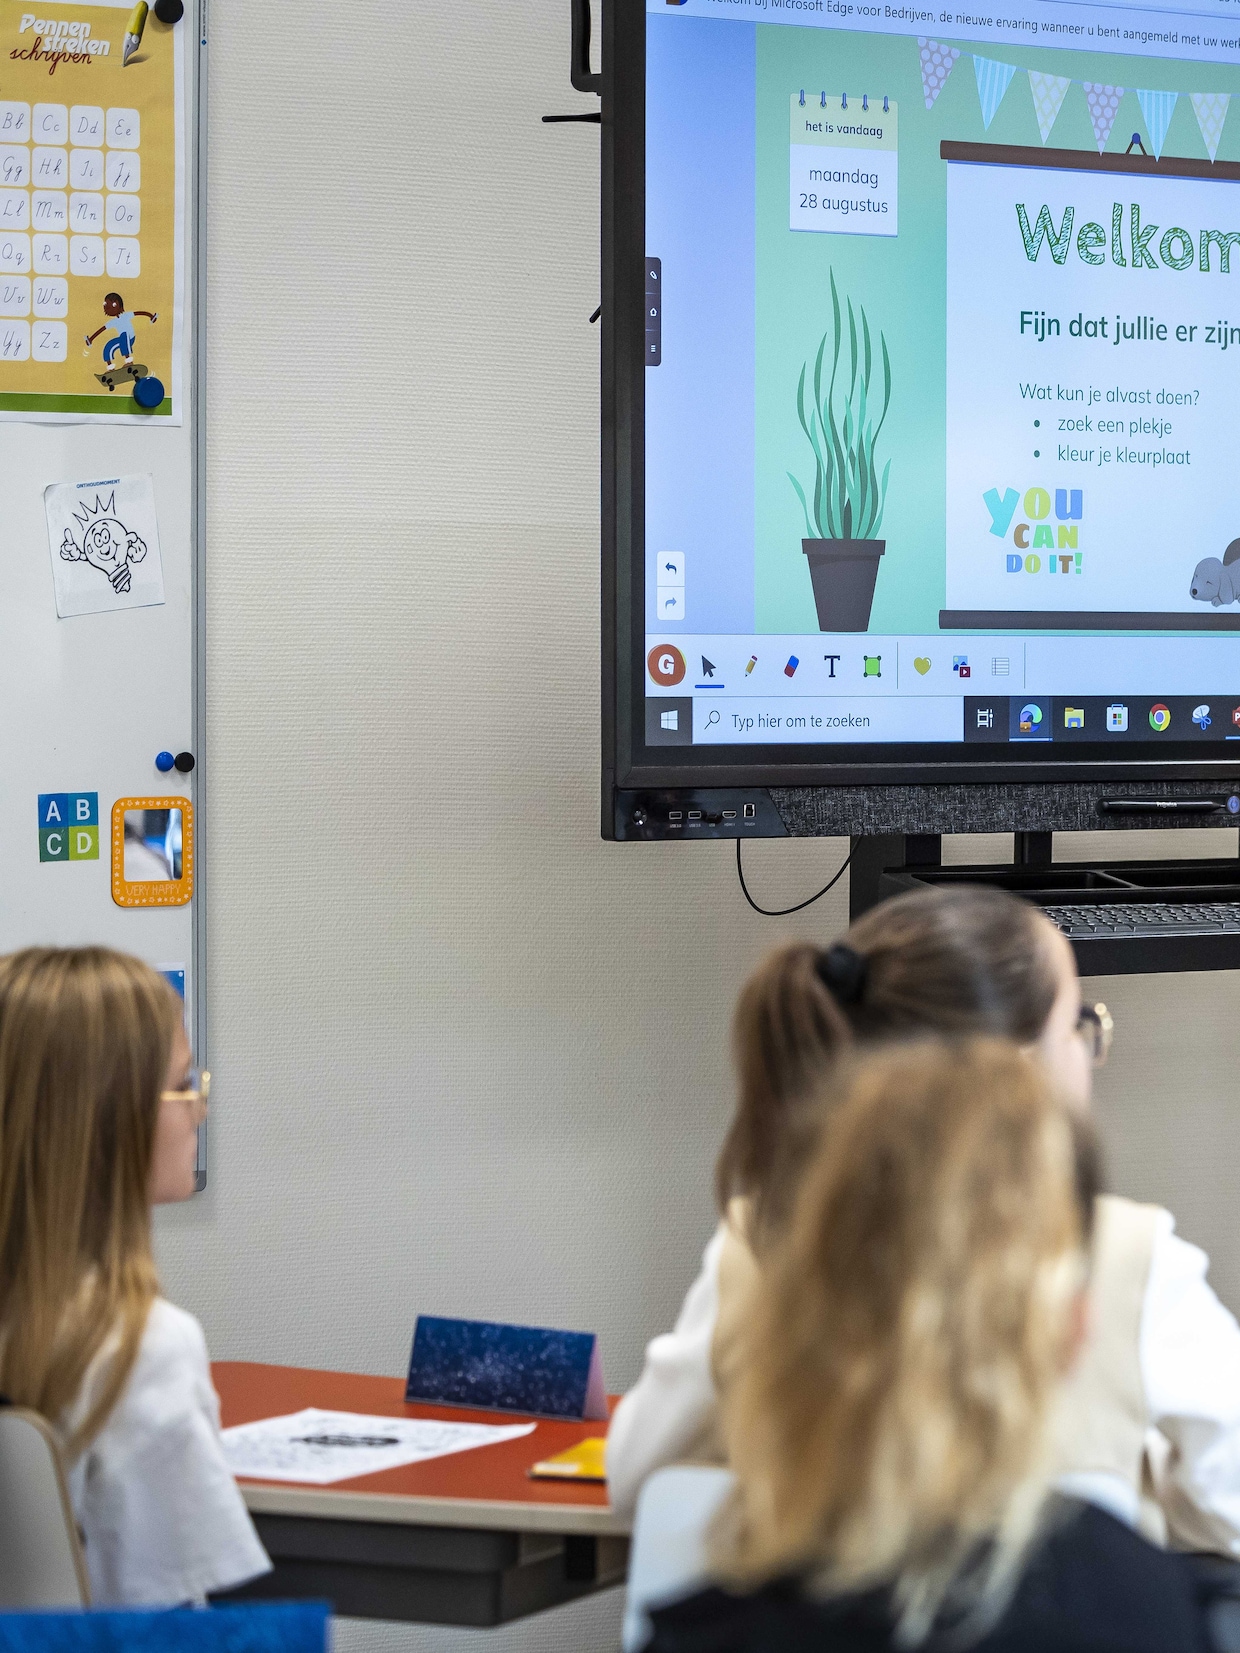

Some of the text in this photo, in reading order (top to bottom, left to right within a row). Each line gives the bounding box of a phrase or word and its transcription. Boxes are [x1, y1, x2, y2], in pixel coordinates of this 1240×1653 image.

[19, 13, 92, 38] Pennen
[771, 0, 824, 12] Microsoft
[827, 1, 854, 17] Edge
[857, 6, 881, 17] voor
[884, 5, 936, 23] Bedrijven,
[939, 10, 953, 23] de
[956, 12, 993, 27] nieuwe
[996, 17, 1038, 34] ervaring
[1041, 22, 1084, 35] wanneer
[1087, 27, 1094, 36] u
[1097, 25, 1121, 39] bent
[1123, 29, 1178, 44] aangemeld
[1181, 33, 1201, 46] met
[1203, 37, 1218, 47] uw
[42, 32, 111, 56] streken
[10, 36, 92, 76] schrijven
[805, 120, 883, 139] het is vandaag
[809, 168, 879, 189] maandag
[799, 193, 889, 215] 28 augustus
[1020, 310, 1061, 342] Fijn
[1068, 313, 1108, 338] dat
[1113, 315, 1168, 346] jullie
[1175, 324, 1198, 342] er
[1019, 382, 1200, 406] Wat kun je alvast doen?
[1057, 415, 1173, 439] zoek een plekje
[1057, 444, 1191, 469] kleur je kleurplaat
[1013, 523, 1079, 549] CAN
[1006, 552, 1083, 575] DO IT!
[657, 653, 676, 676] G
[732, 713, 870, 731] Typ hier om te zoeken
[46, 799, 91, 822] A B
[46, 832, 93, 855] C D
[125, 883, 182, 896] VERY HAPPY
